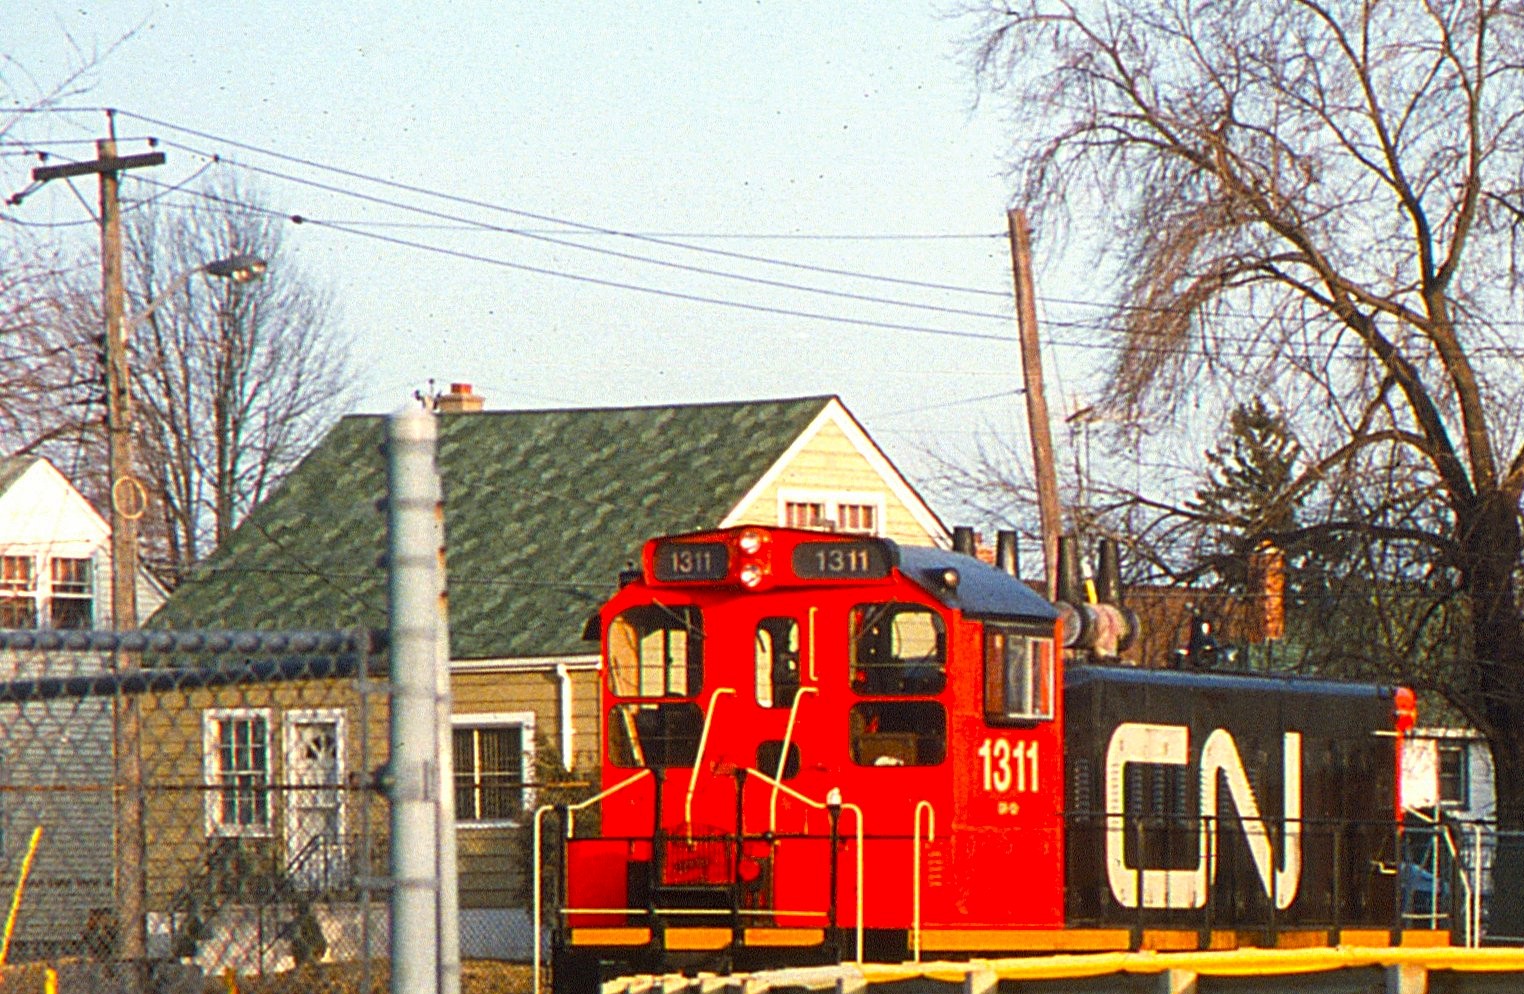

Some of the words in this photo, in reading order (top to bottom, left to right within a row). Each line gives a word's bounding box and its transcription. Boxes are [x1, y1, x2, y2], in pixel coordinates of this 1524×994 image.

[672, 550, 712, 573] 1311
[815, 549, 869, 572] 1311
[979, 738, 1039, 792] 1311
[1106, 722, 1303, 911] CN
